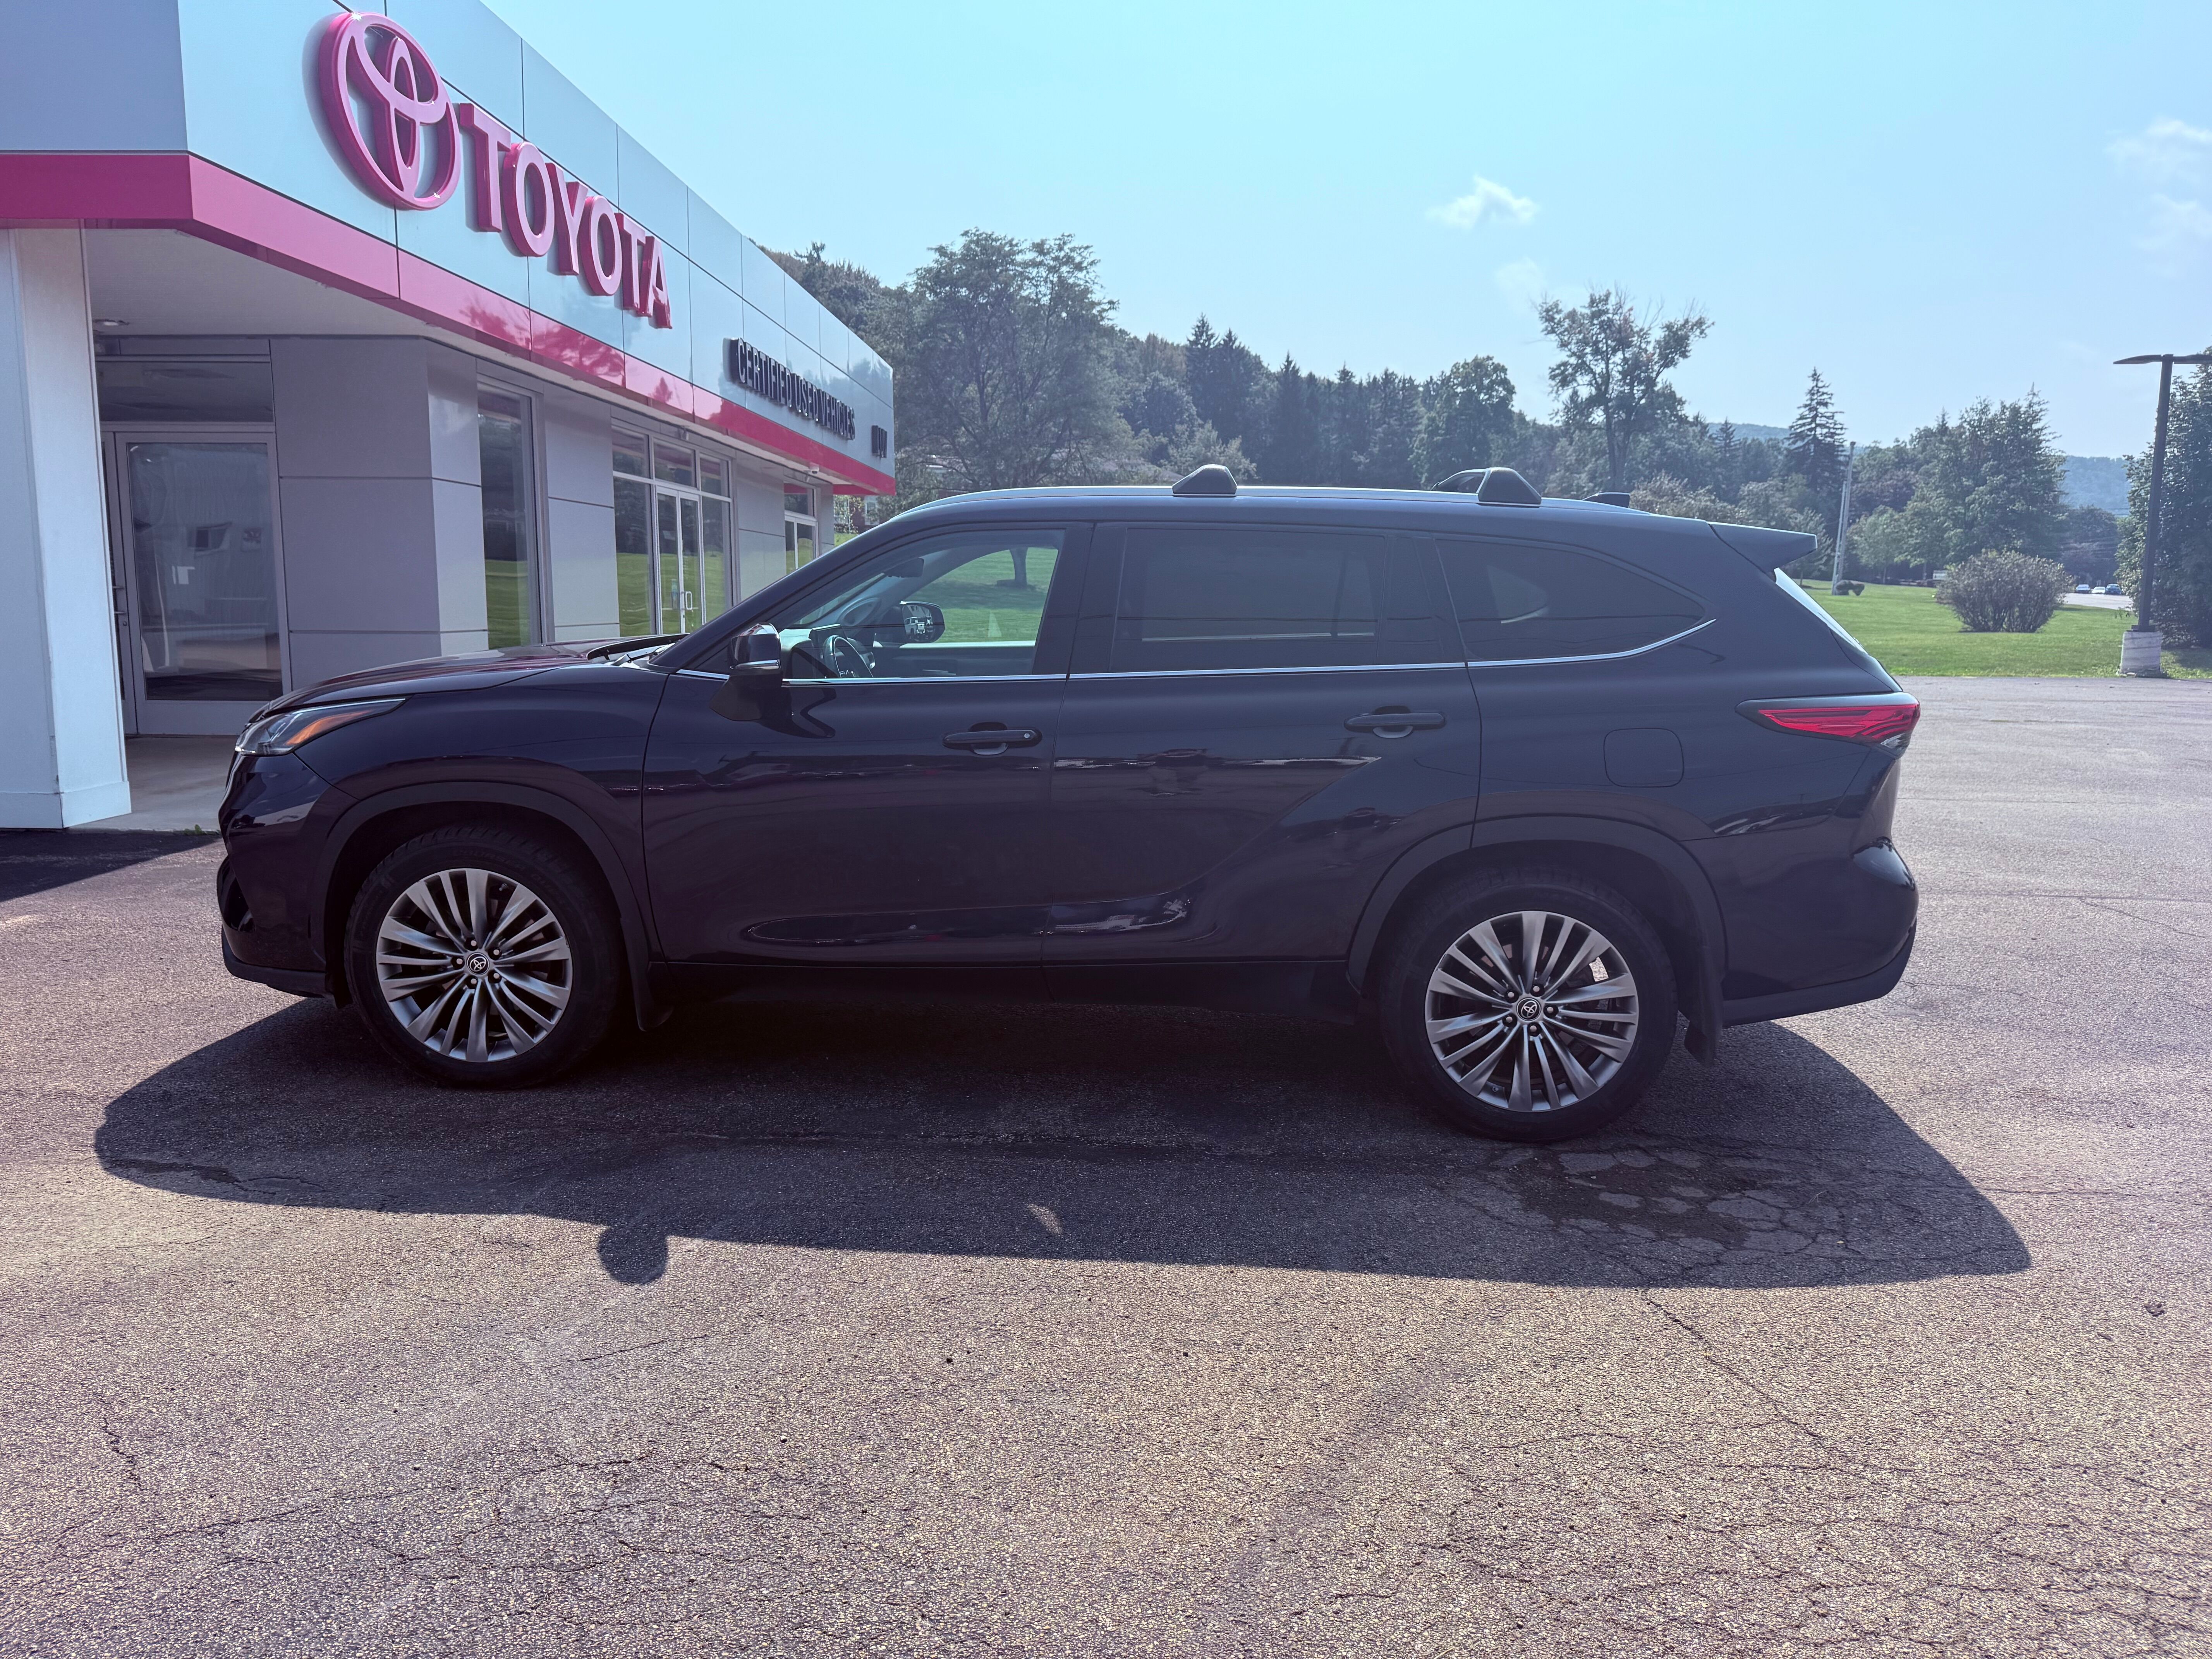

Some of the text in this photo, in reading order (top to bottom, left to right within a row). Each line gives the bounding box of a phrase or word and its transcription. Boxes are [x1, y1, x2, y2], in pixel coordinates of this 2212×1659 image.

[460, 103, 673, 329] TOYOTA
[732, 337, 855, 440] CERTIFIED USED VEHICLES
